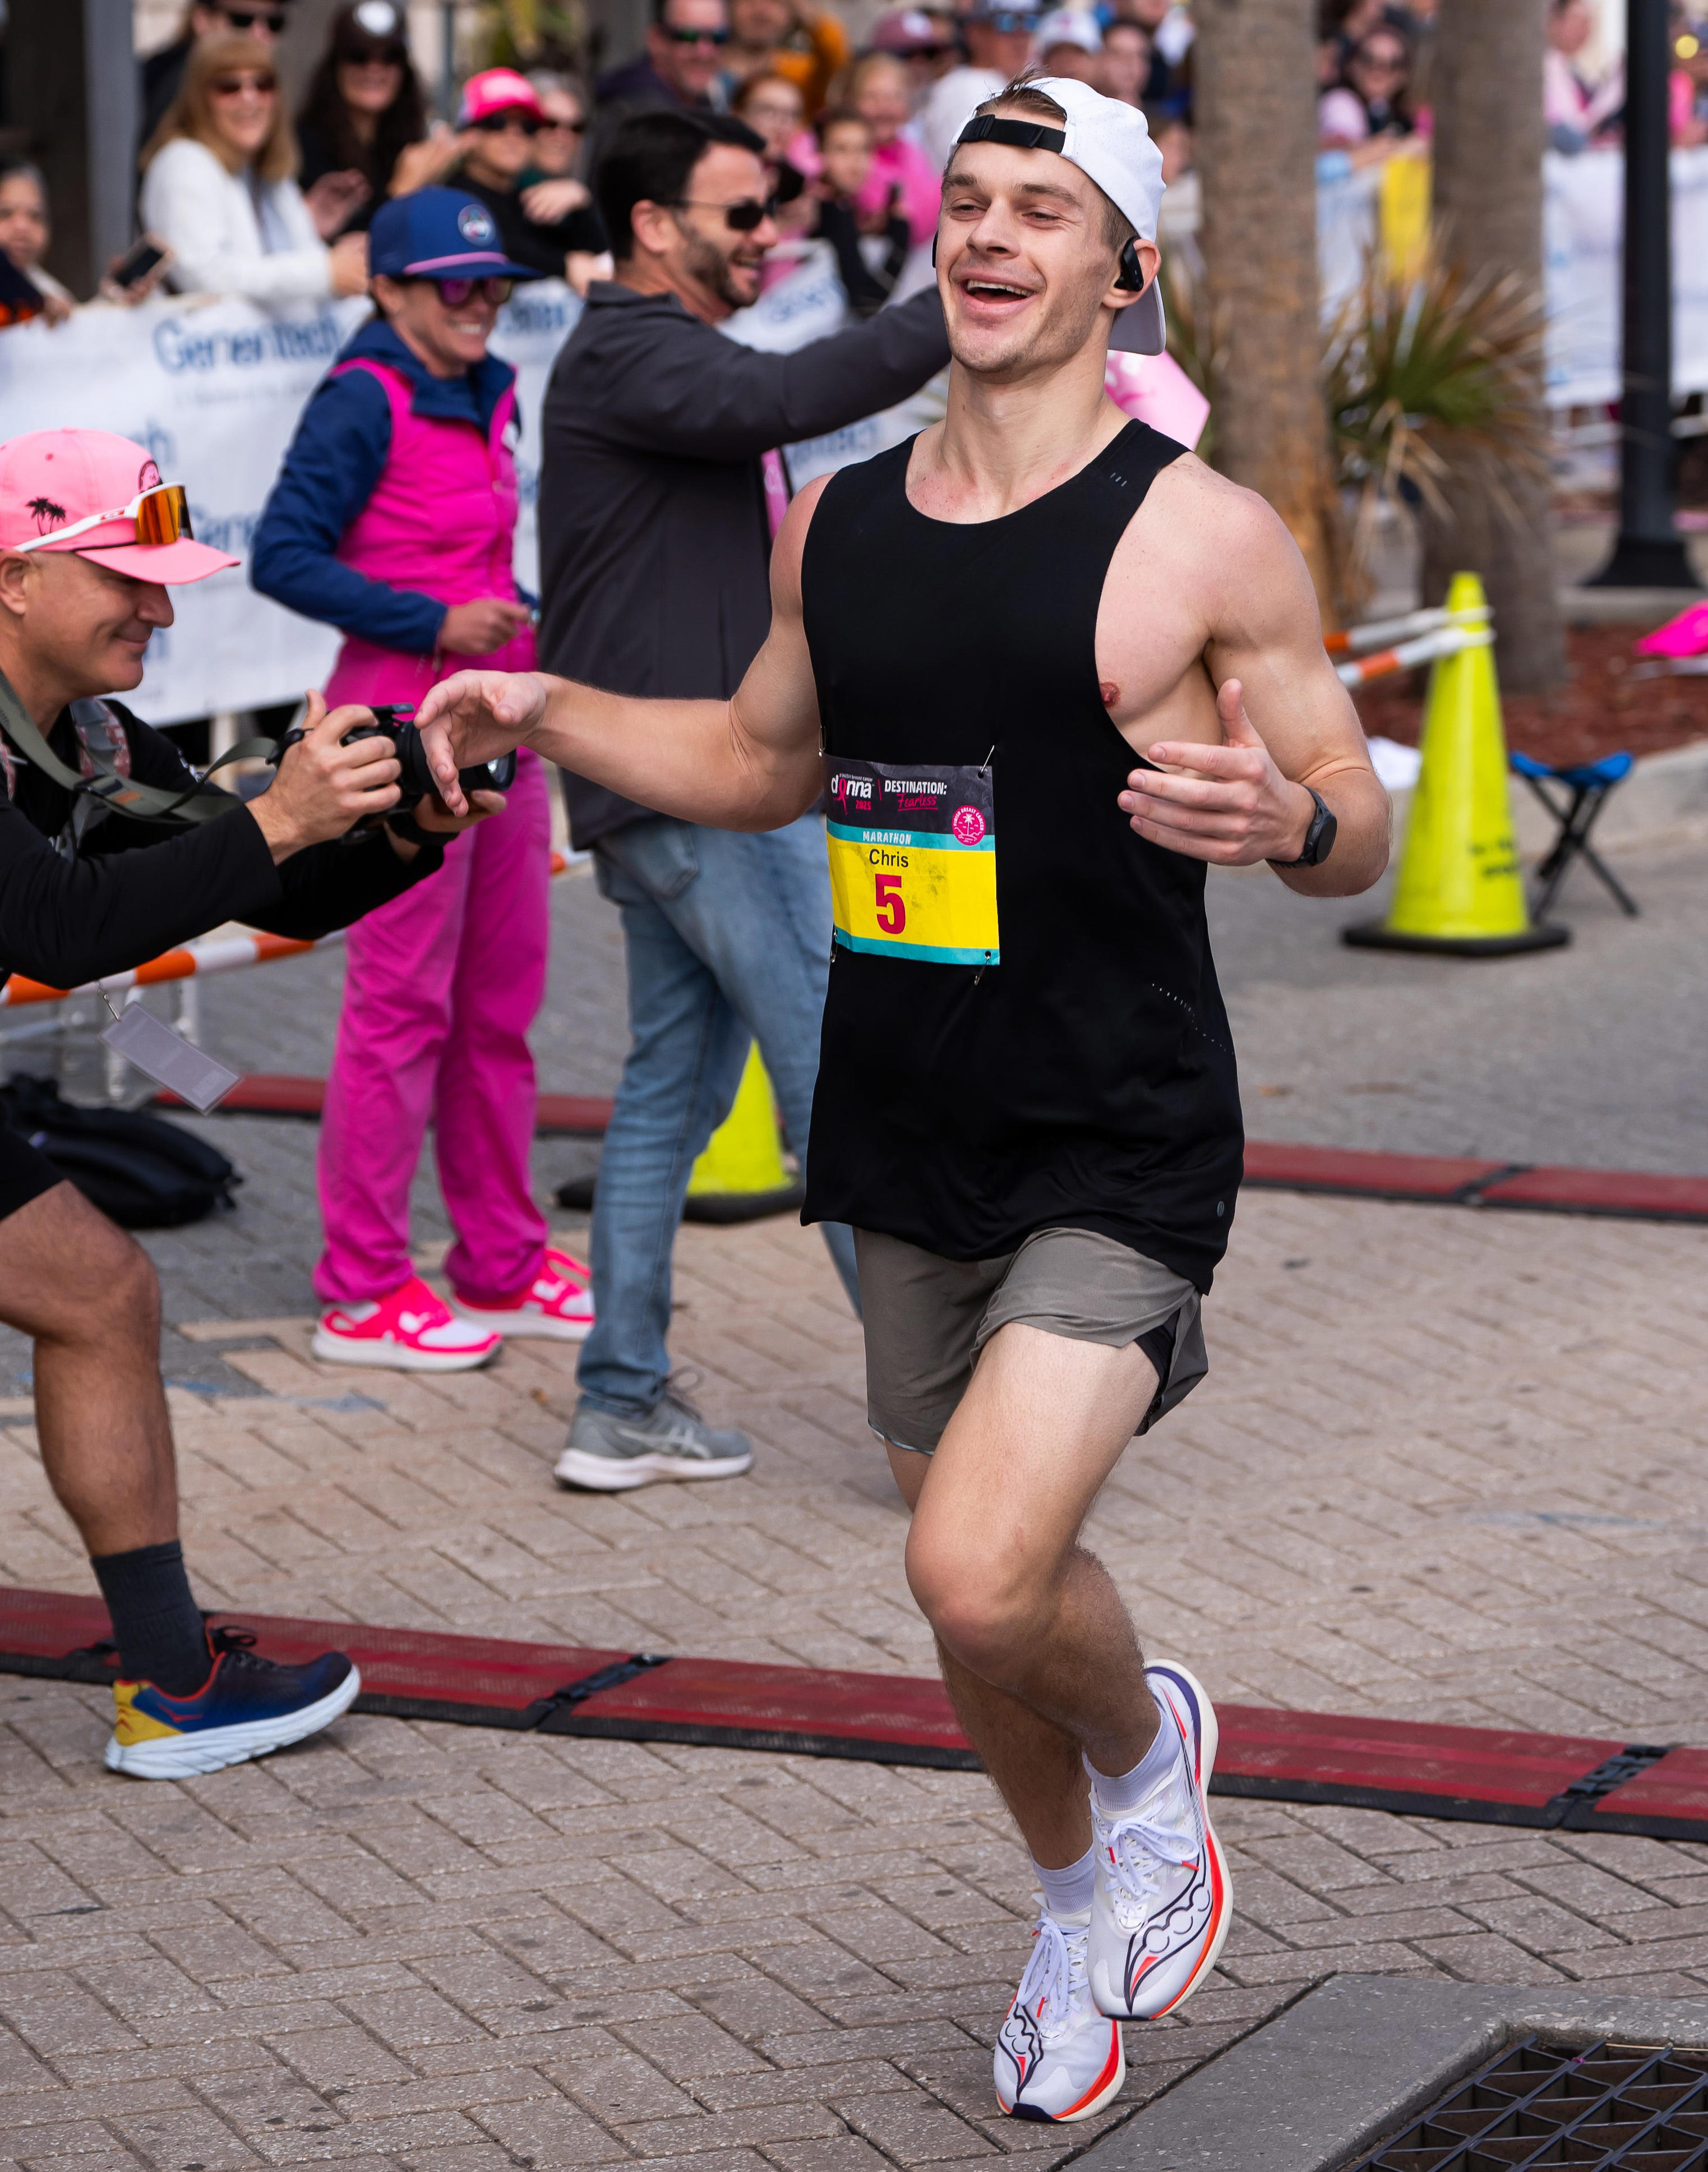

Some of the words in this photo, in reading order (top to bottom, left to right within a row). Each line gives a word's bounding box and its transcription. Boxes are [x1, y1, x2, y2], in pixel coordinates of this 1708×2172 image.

[884, 780, 948, 795] DESTINATION:
[856, 800, 871, 810] 2025
[897, 791, 938, 808] Fearless
[862, 831, 911, 845] MARATHON
[869, 848, 908, 868] Chris
[875, 873, 906, 934] 5
